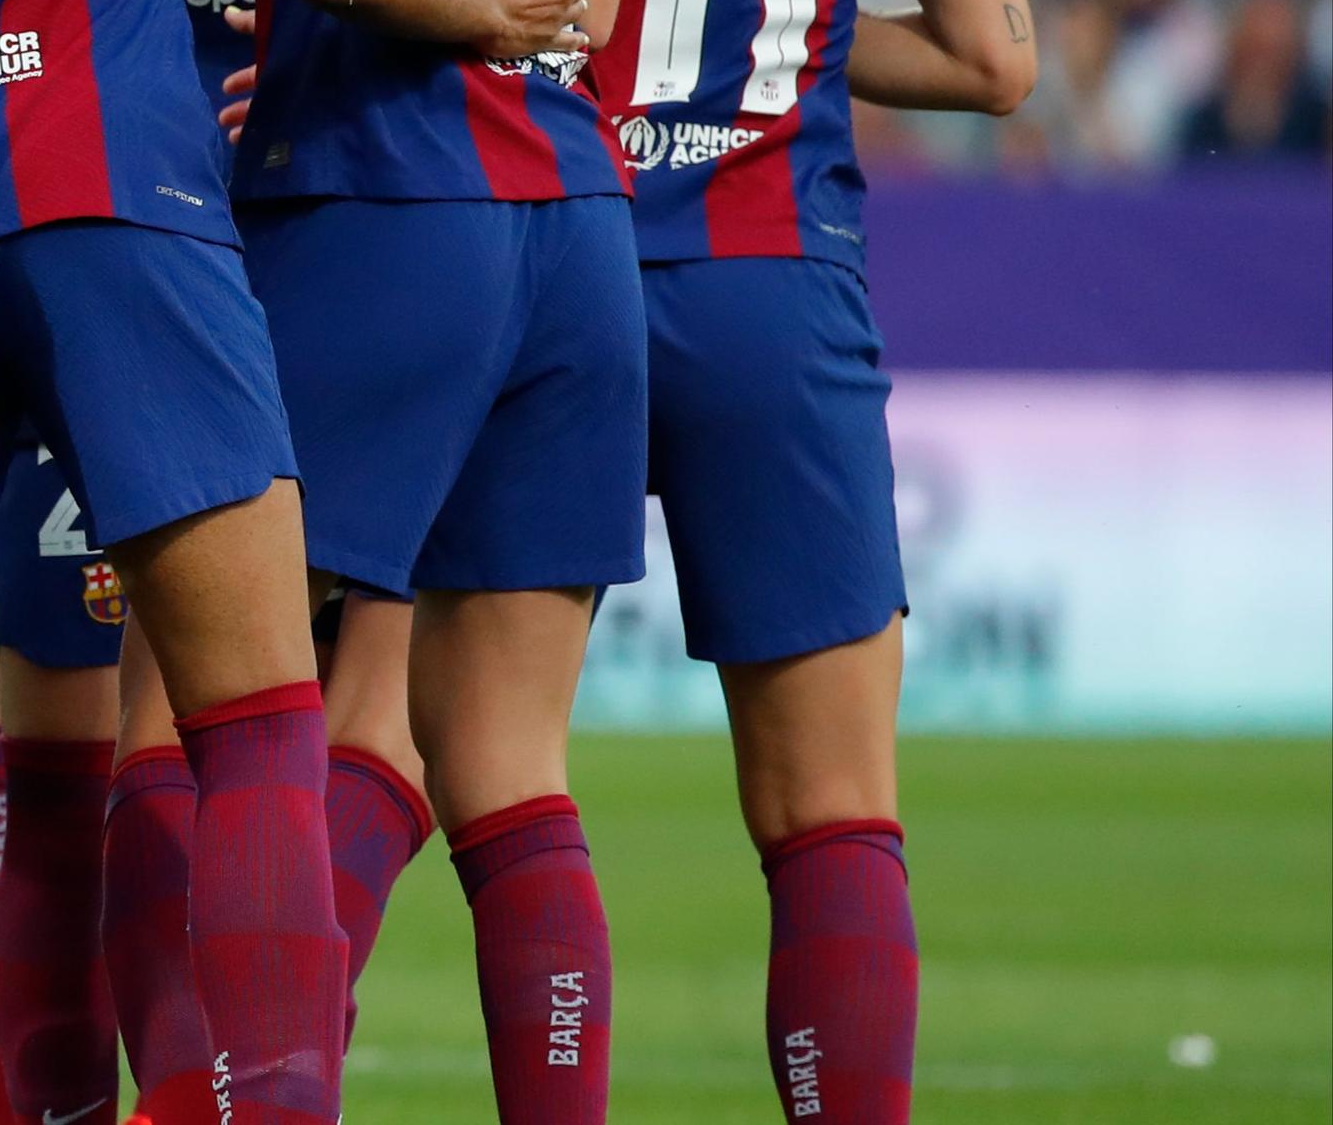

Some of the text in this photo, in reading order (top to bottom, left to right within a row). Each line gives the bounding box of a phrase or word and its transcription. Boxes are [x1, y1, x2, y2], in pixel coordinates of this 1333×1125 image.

[11, 70, 43, 83] Agency
[548, 971, 589, 1066] BARÇA
[212, 1050, 233, 1125] ARÇA
[785, 1026, 823, 1117] BARÇA
